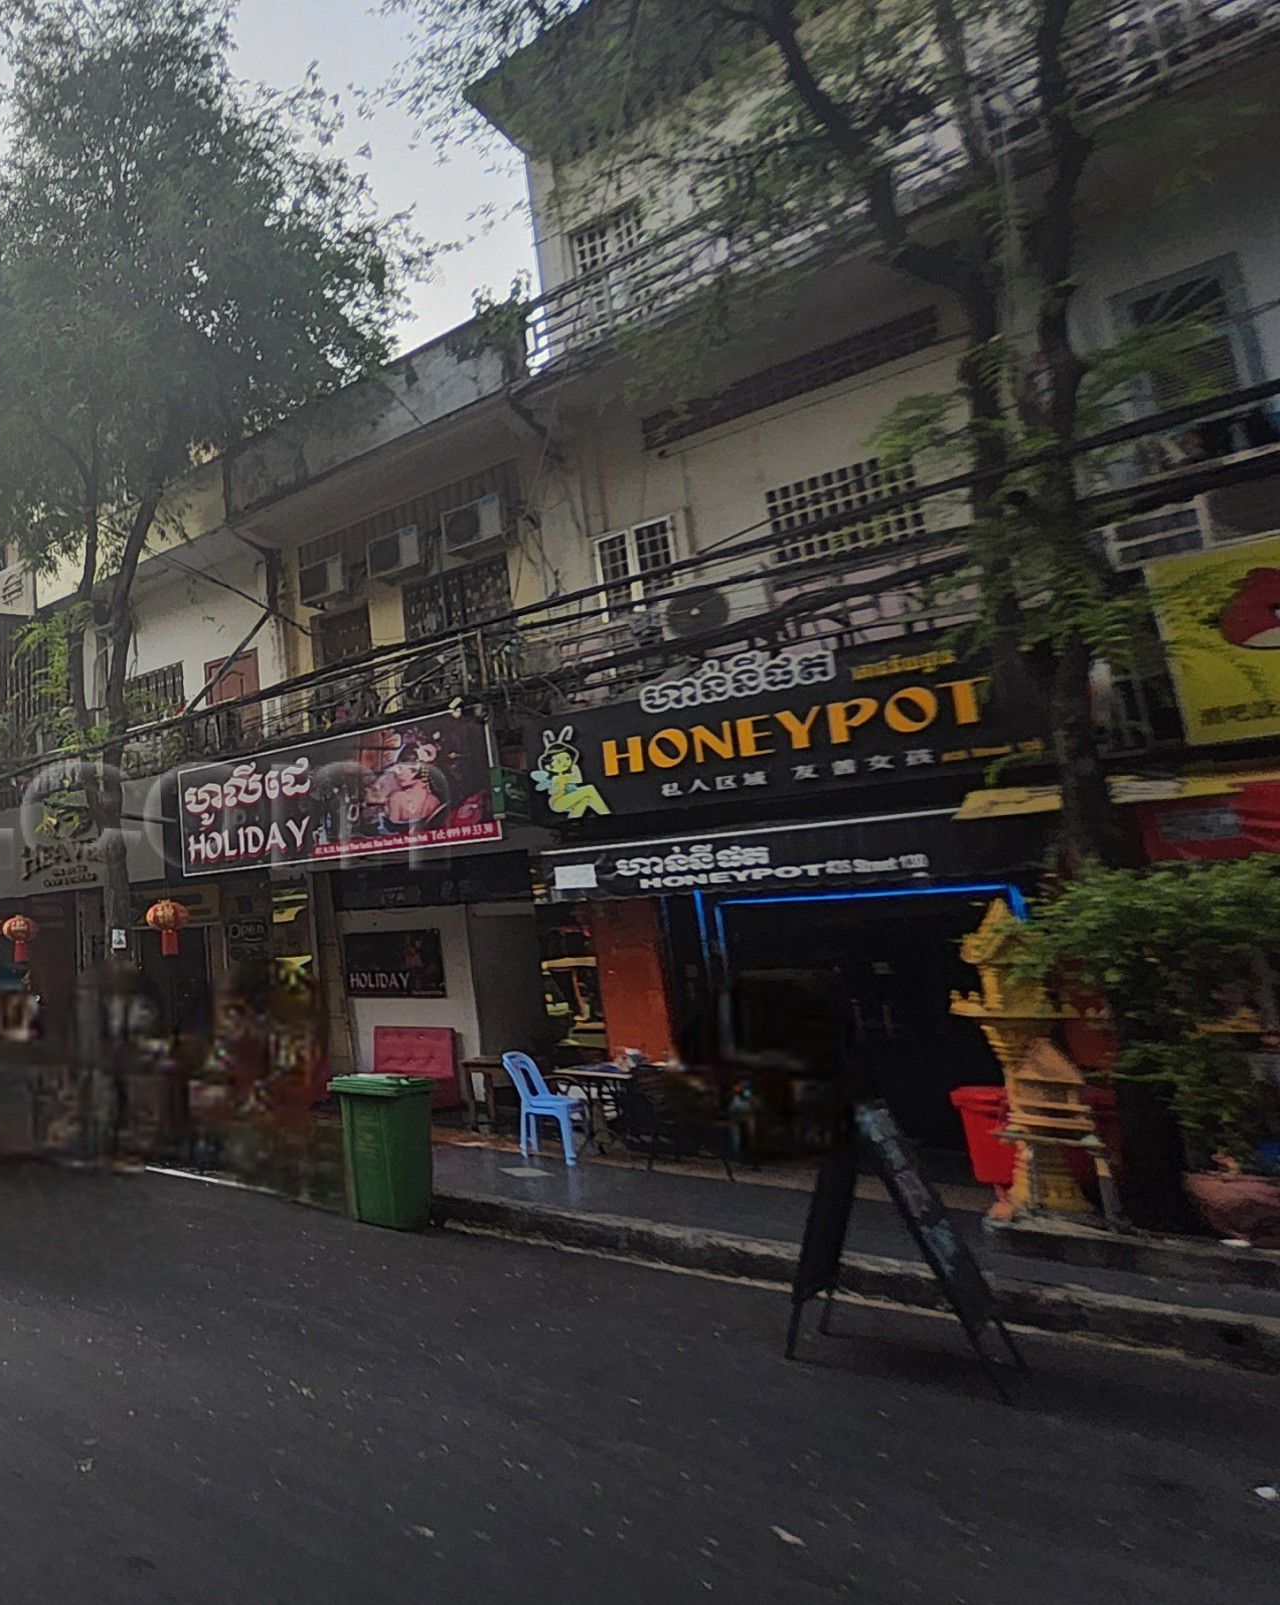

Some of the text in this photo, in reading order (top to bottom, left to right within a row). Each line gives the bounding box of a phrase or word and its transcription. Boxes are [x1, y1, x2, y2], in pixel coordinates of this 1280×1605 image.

[601, 676, 989, 777] HONEYPOT
[188, 815, 310, 864] HOLIDAY
[639, 863, 826, 889] HONEYPOT
[350, 972, 411, 990] HOLIDAY
